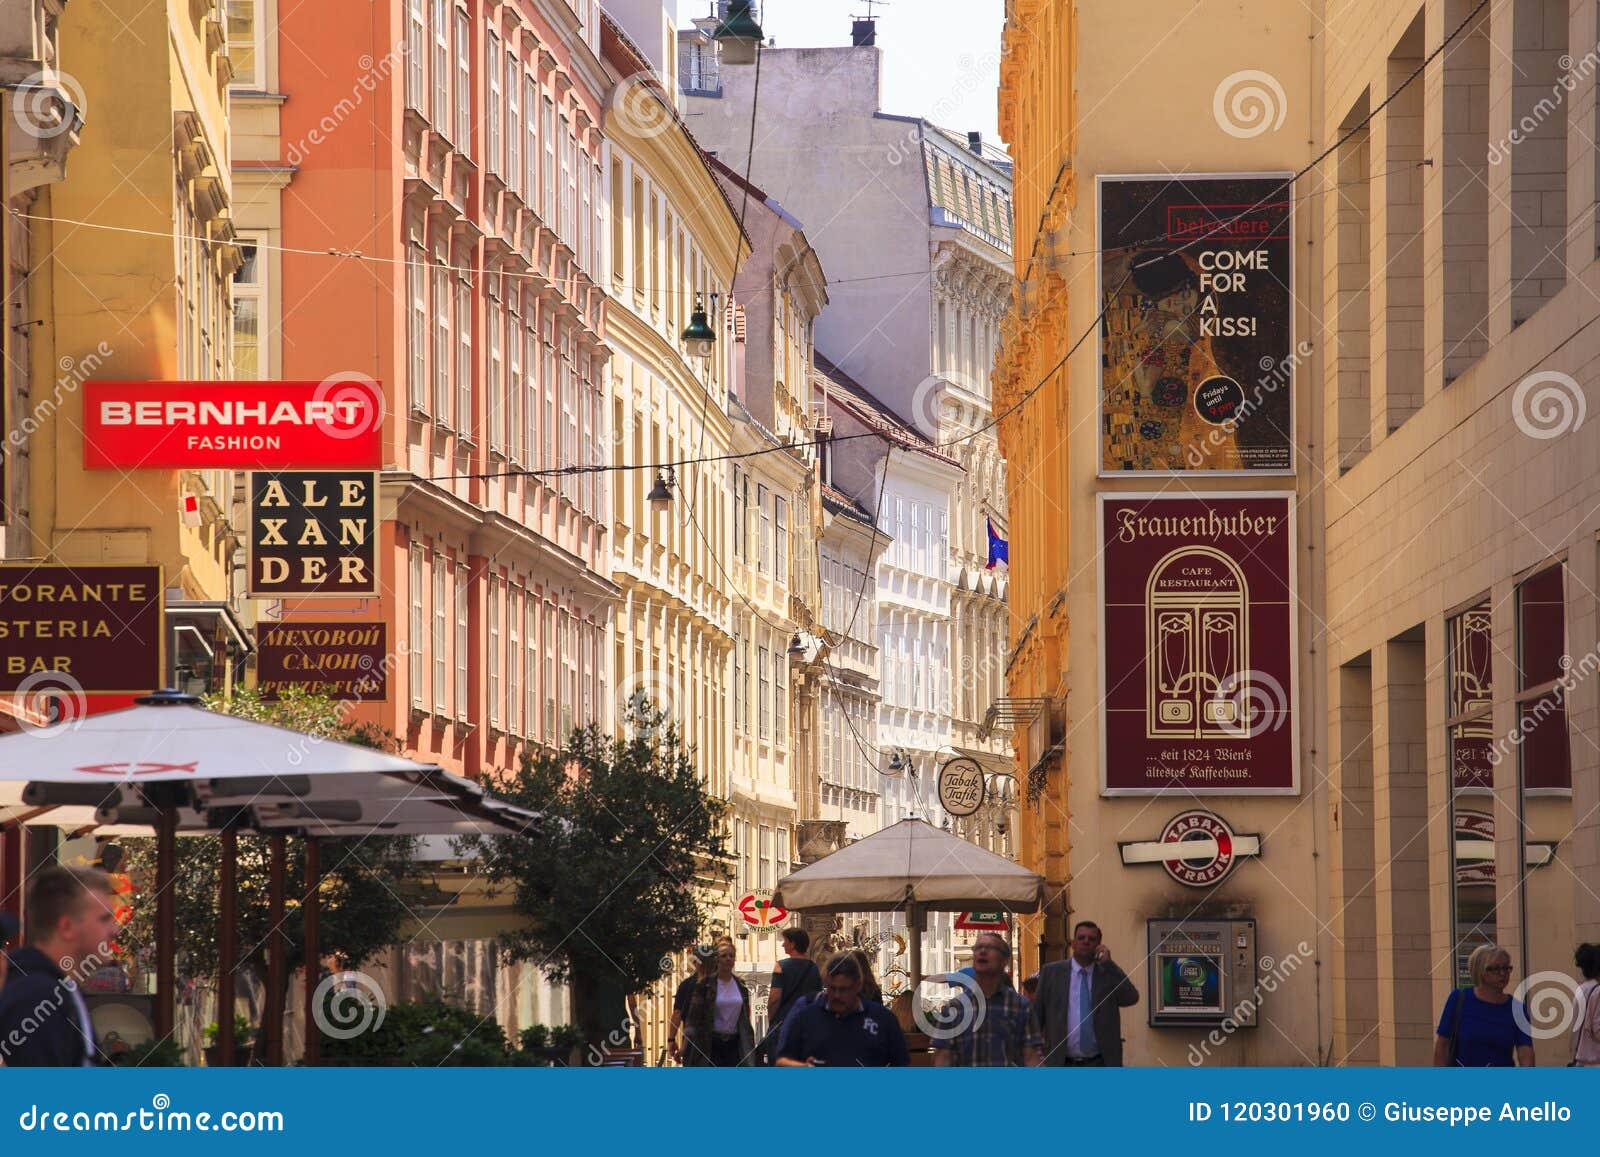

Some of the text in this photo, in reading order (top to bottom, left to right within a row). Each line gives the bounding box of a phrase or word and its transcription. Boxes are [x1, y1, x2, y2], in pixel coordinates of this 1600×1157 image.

[1176, 216, 1270, 236] belvedere
[1199, 250, 1269, 271] COME
[1200, 273, 1246, 293] FOR
[1200, 296, 1217, 315] A
[1200, 317, 1257, 337] KISS!
[1202, 385, 1229, 400] Fridays
[1206, 394, 1222, 407] until
[101, 401, 364, 425] BERNHART
[187, 436, 281, 450] FASHION
[260, 480, 366, 507] ALE
[260, 518, 367, 545] XAN
[1116, 508, 1277, 542] Frauenhuber
[260, 557, 367, 584] DER
[1181, 567, 1212, 576] CAFE
[1160, 579, 1236, 588] RESTAURANT
[265, 625, 381, 646] МЕХОВОЙ
[7, 656, 72, 674] BAR
[282, 653, 360, 670] САЛОН
[1160, 749, 1179, 761] seit
[1183, 749, 1210, 761] 1824
[1214, 748, 1252, 761] Wien's
[944, 766, 979, 788] Tabak
[1146, 767, 1252, 779] ältestes Kaffeehaus.
[944, 786, 979, 808] Trafik
[1169, 818, 1224, 838] TABAK
[1175, 852, 1230, 881] TRAFIK
